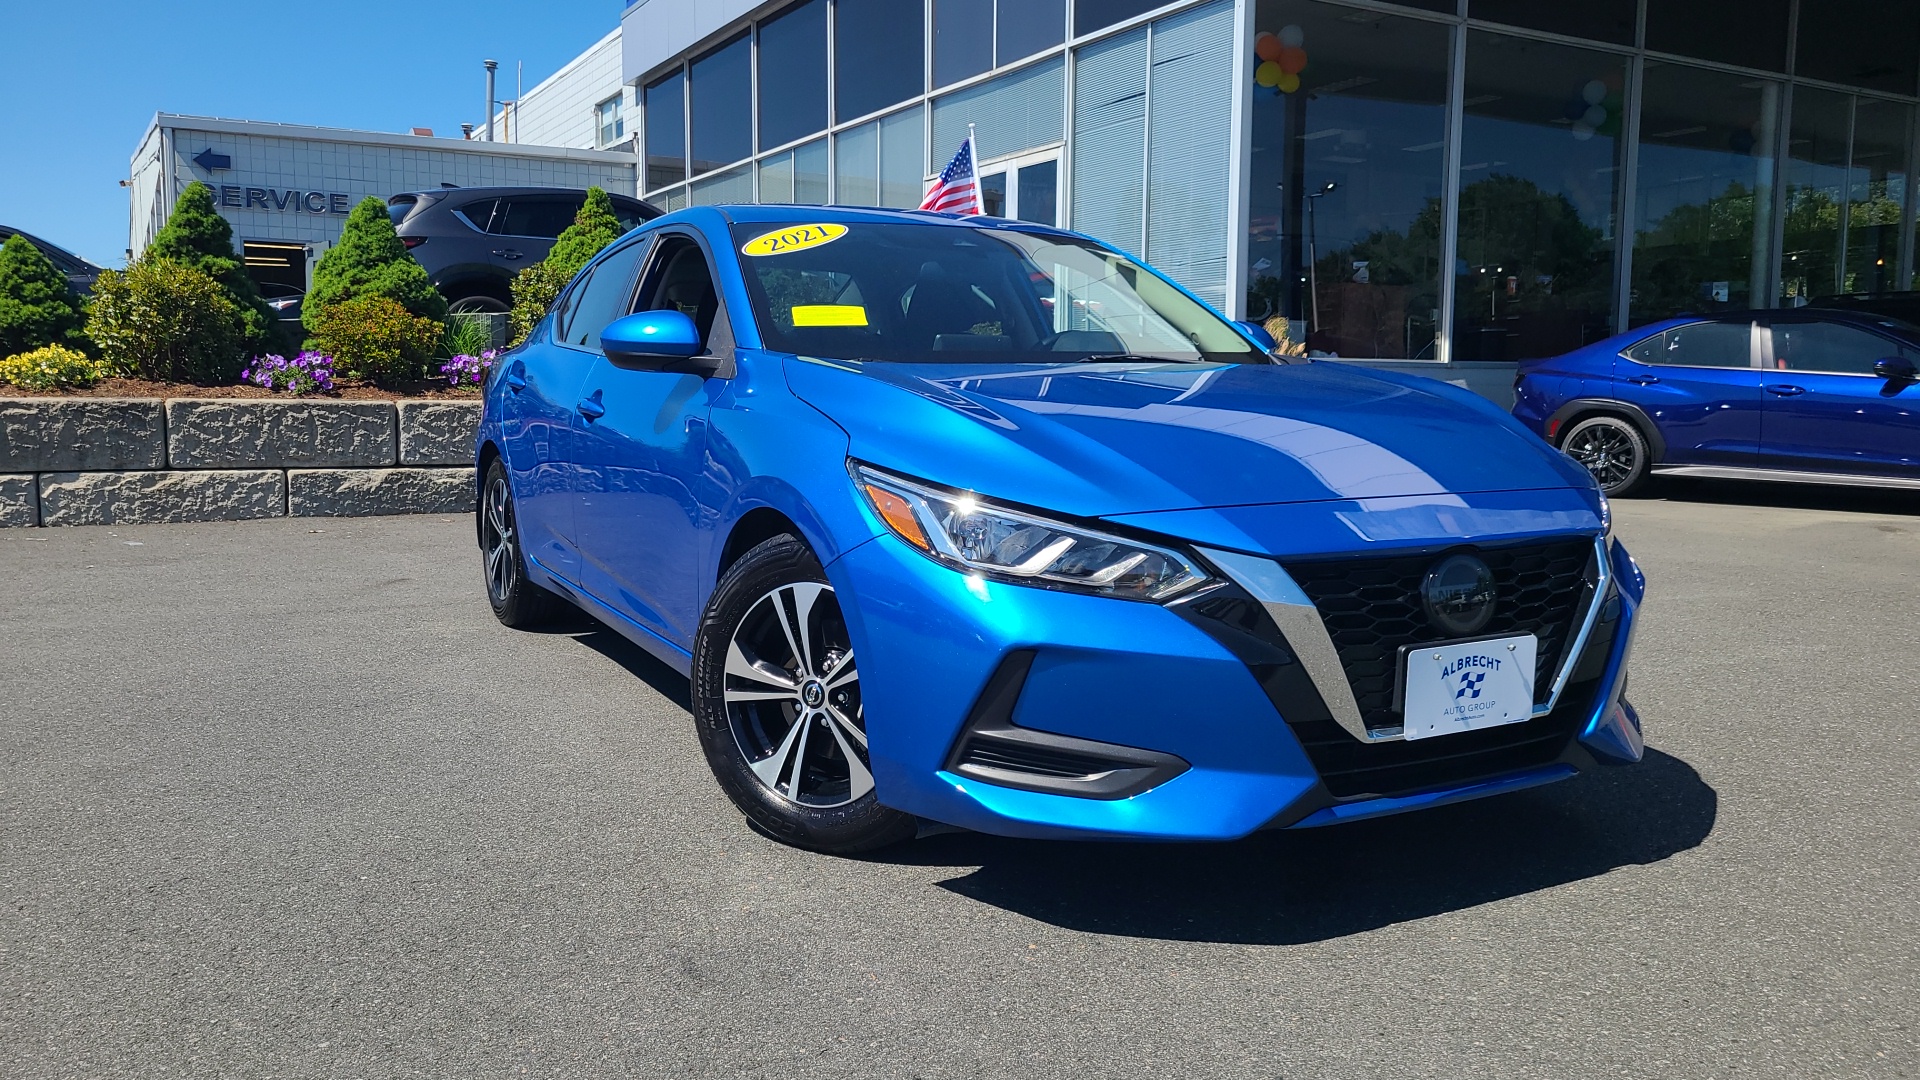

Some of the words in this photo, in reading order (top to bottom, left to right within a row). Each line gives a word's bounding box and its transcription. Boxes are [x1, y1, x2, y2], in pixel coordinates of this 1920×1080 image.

[763, 226, 832, 252] 2021
[1441, 655, 1502, 680] ALBRECHT
[1443, 705, 1466, 716] AUTO
[1467, 700, 1496, 712] GROUP
